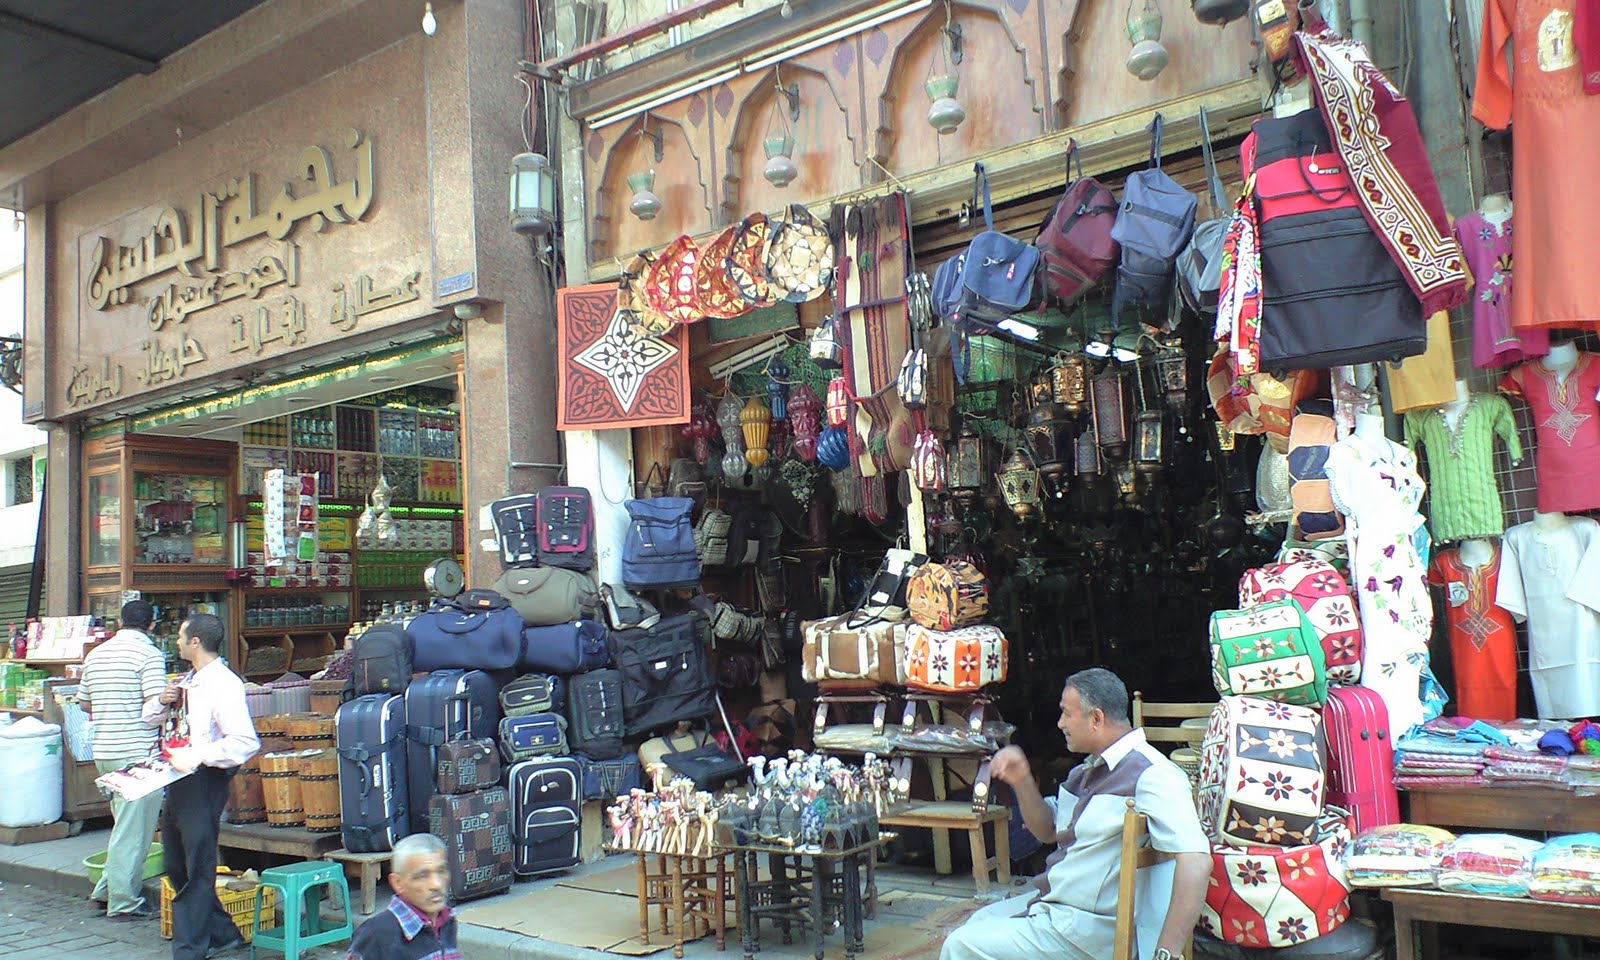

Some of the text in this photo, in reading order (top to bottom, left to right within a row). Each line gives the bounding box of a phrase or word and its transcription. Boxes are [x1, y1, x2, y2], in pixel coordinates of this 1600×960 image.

[86, 127, 375, 311] نجمة الحسين
[148, 241, 298, 331] احمد عثمان
[331, 272, 421, 331] عطارة
